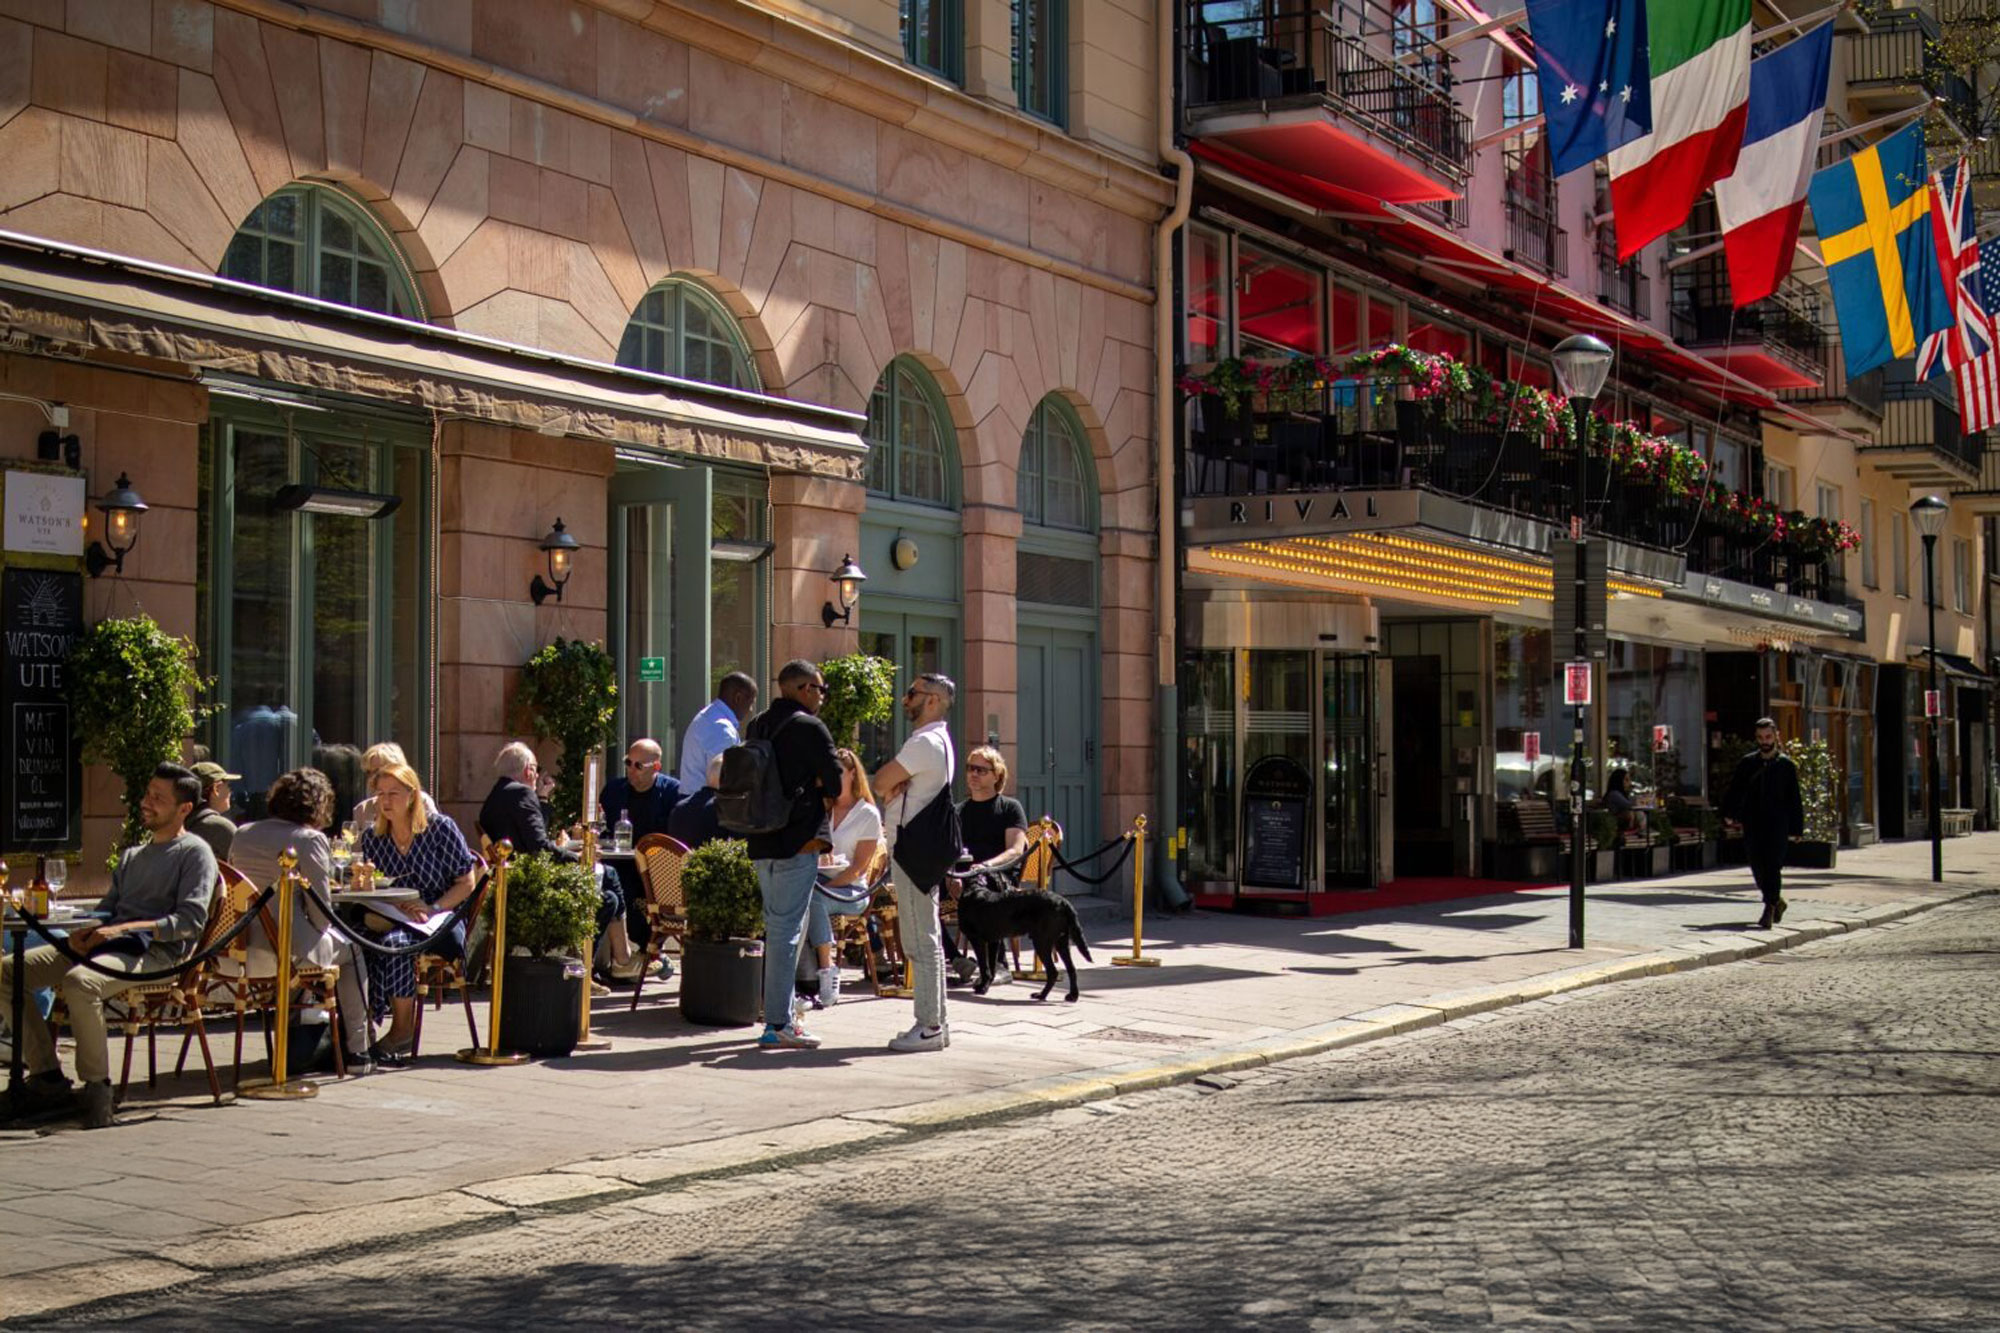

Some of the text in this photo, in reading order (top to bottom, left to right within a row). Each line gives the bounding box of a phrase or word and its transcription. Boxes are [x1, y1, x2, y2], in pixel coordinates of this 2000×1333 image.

[1230, 496, 1379, 523] RIVAL
[19, 513, 72, 528] WATSON'S
[20, 663, 62, 688] UTE
[25, 711, 58, 732] MAT
[25, 737, 54, 755] VIN
